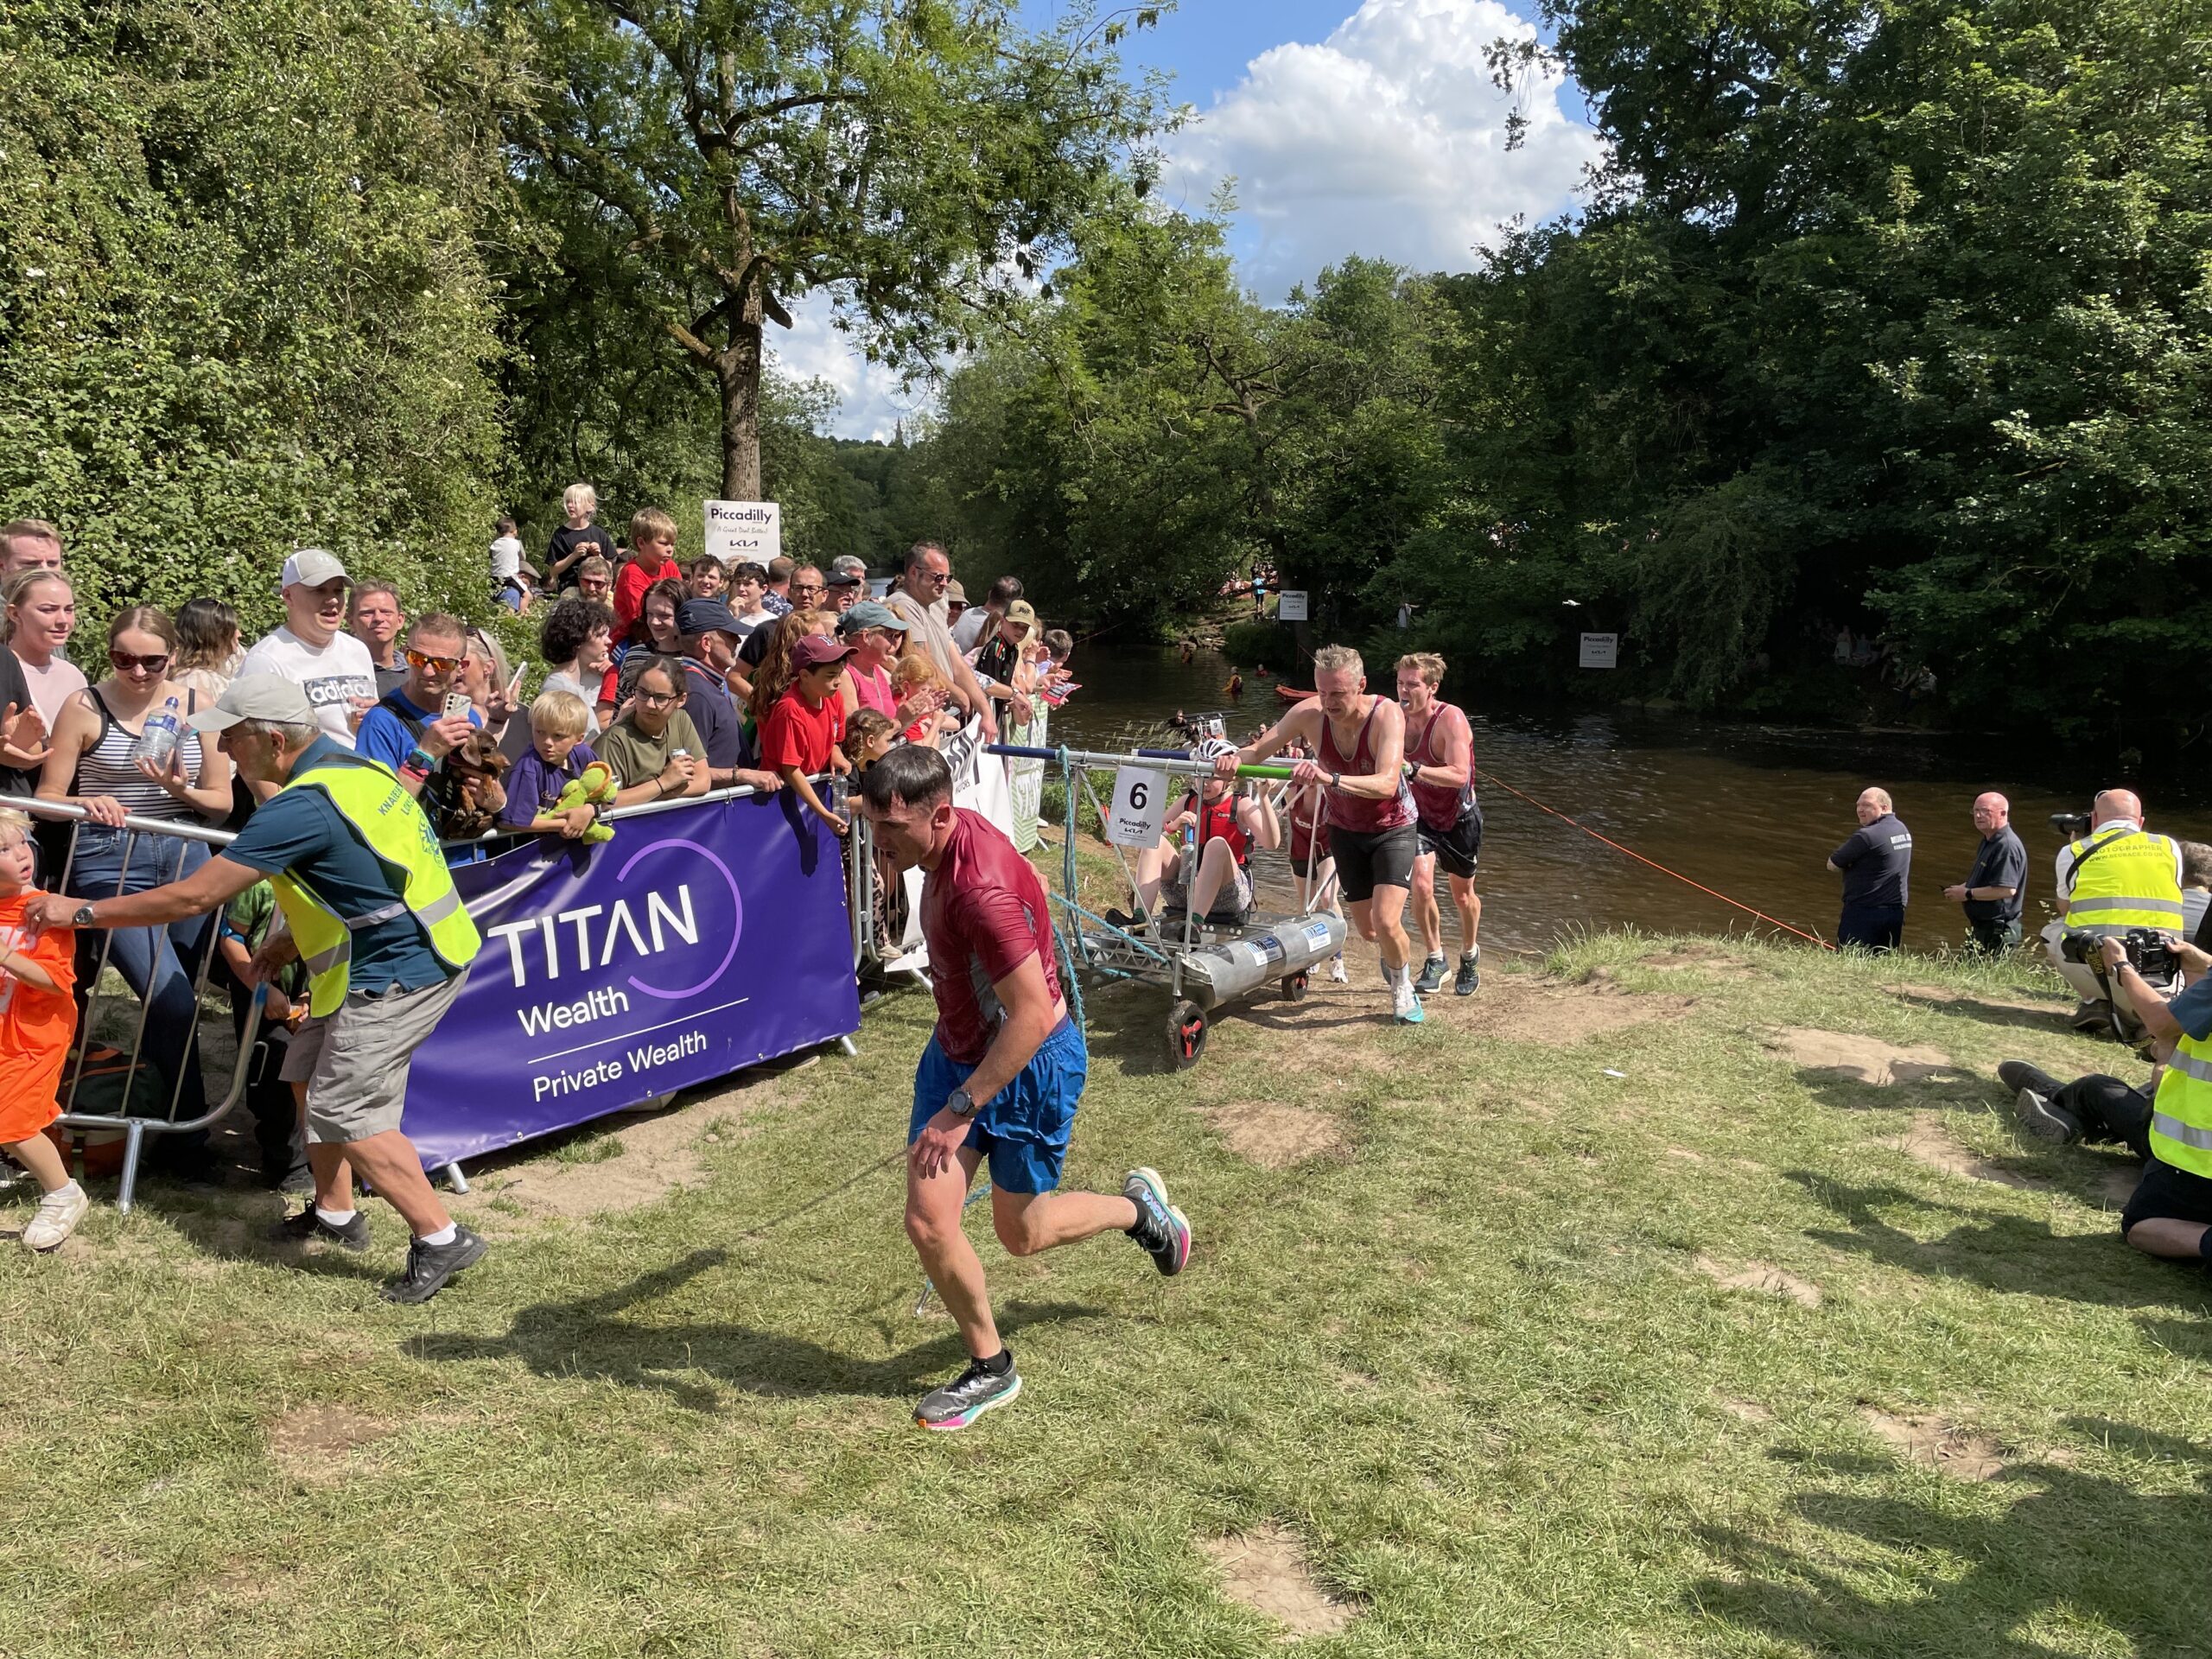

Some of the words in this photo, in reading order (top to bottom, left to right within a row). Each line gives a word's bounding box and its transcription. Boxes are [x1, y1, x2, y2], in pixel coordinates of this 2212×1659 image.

[710, 507, 772, 524] Piccadilly
[310, 678, 369, 702] adida
[1129, 782, 1148, 810] 6
[1119, 817, 1152, 830] Piccadilly
[486, 884, 699, 988] TITAN
[517, 986, 629, 1037] Wealth
[533, 1059, 623, 1103] Private
[626, 1030, 707, 1073] Wealth
